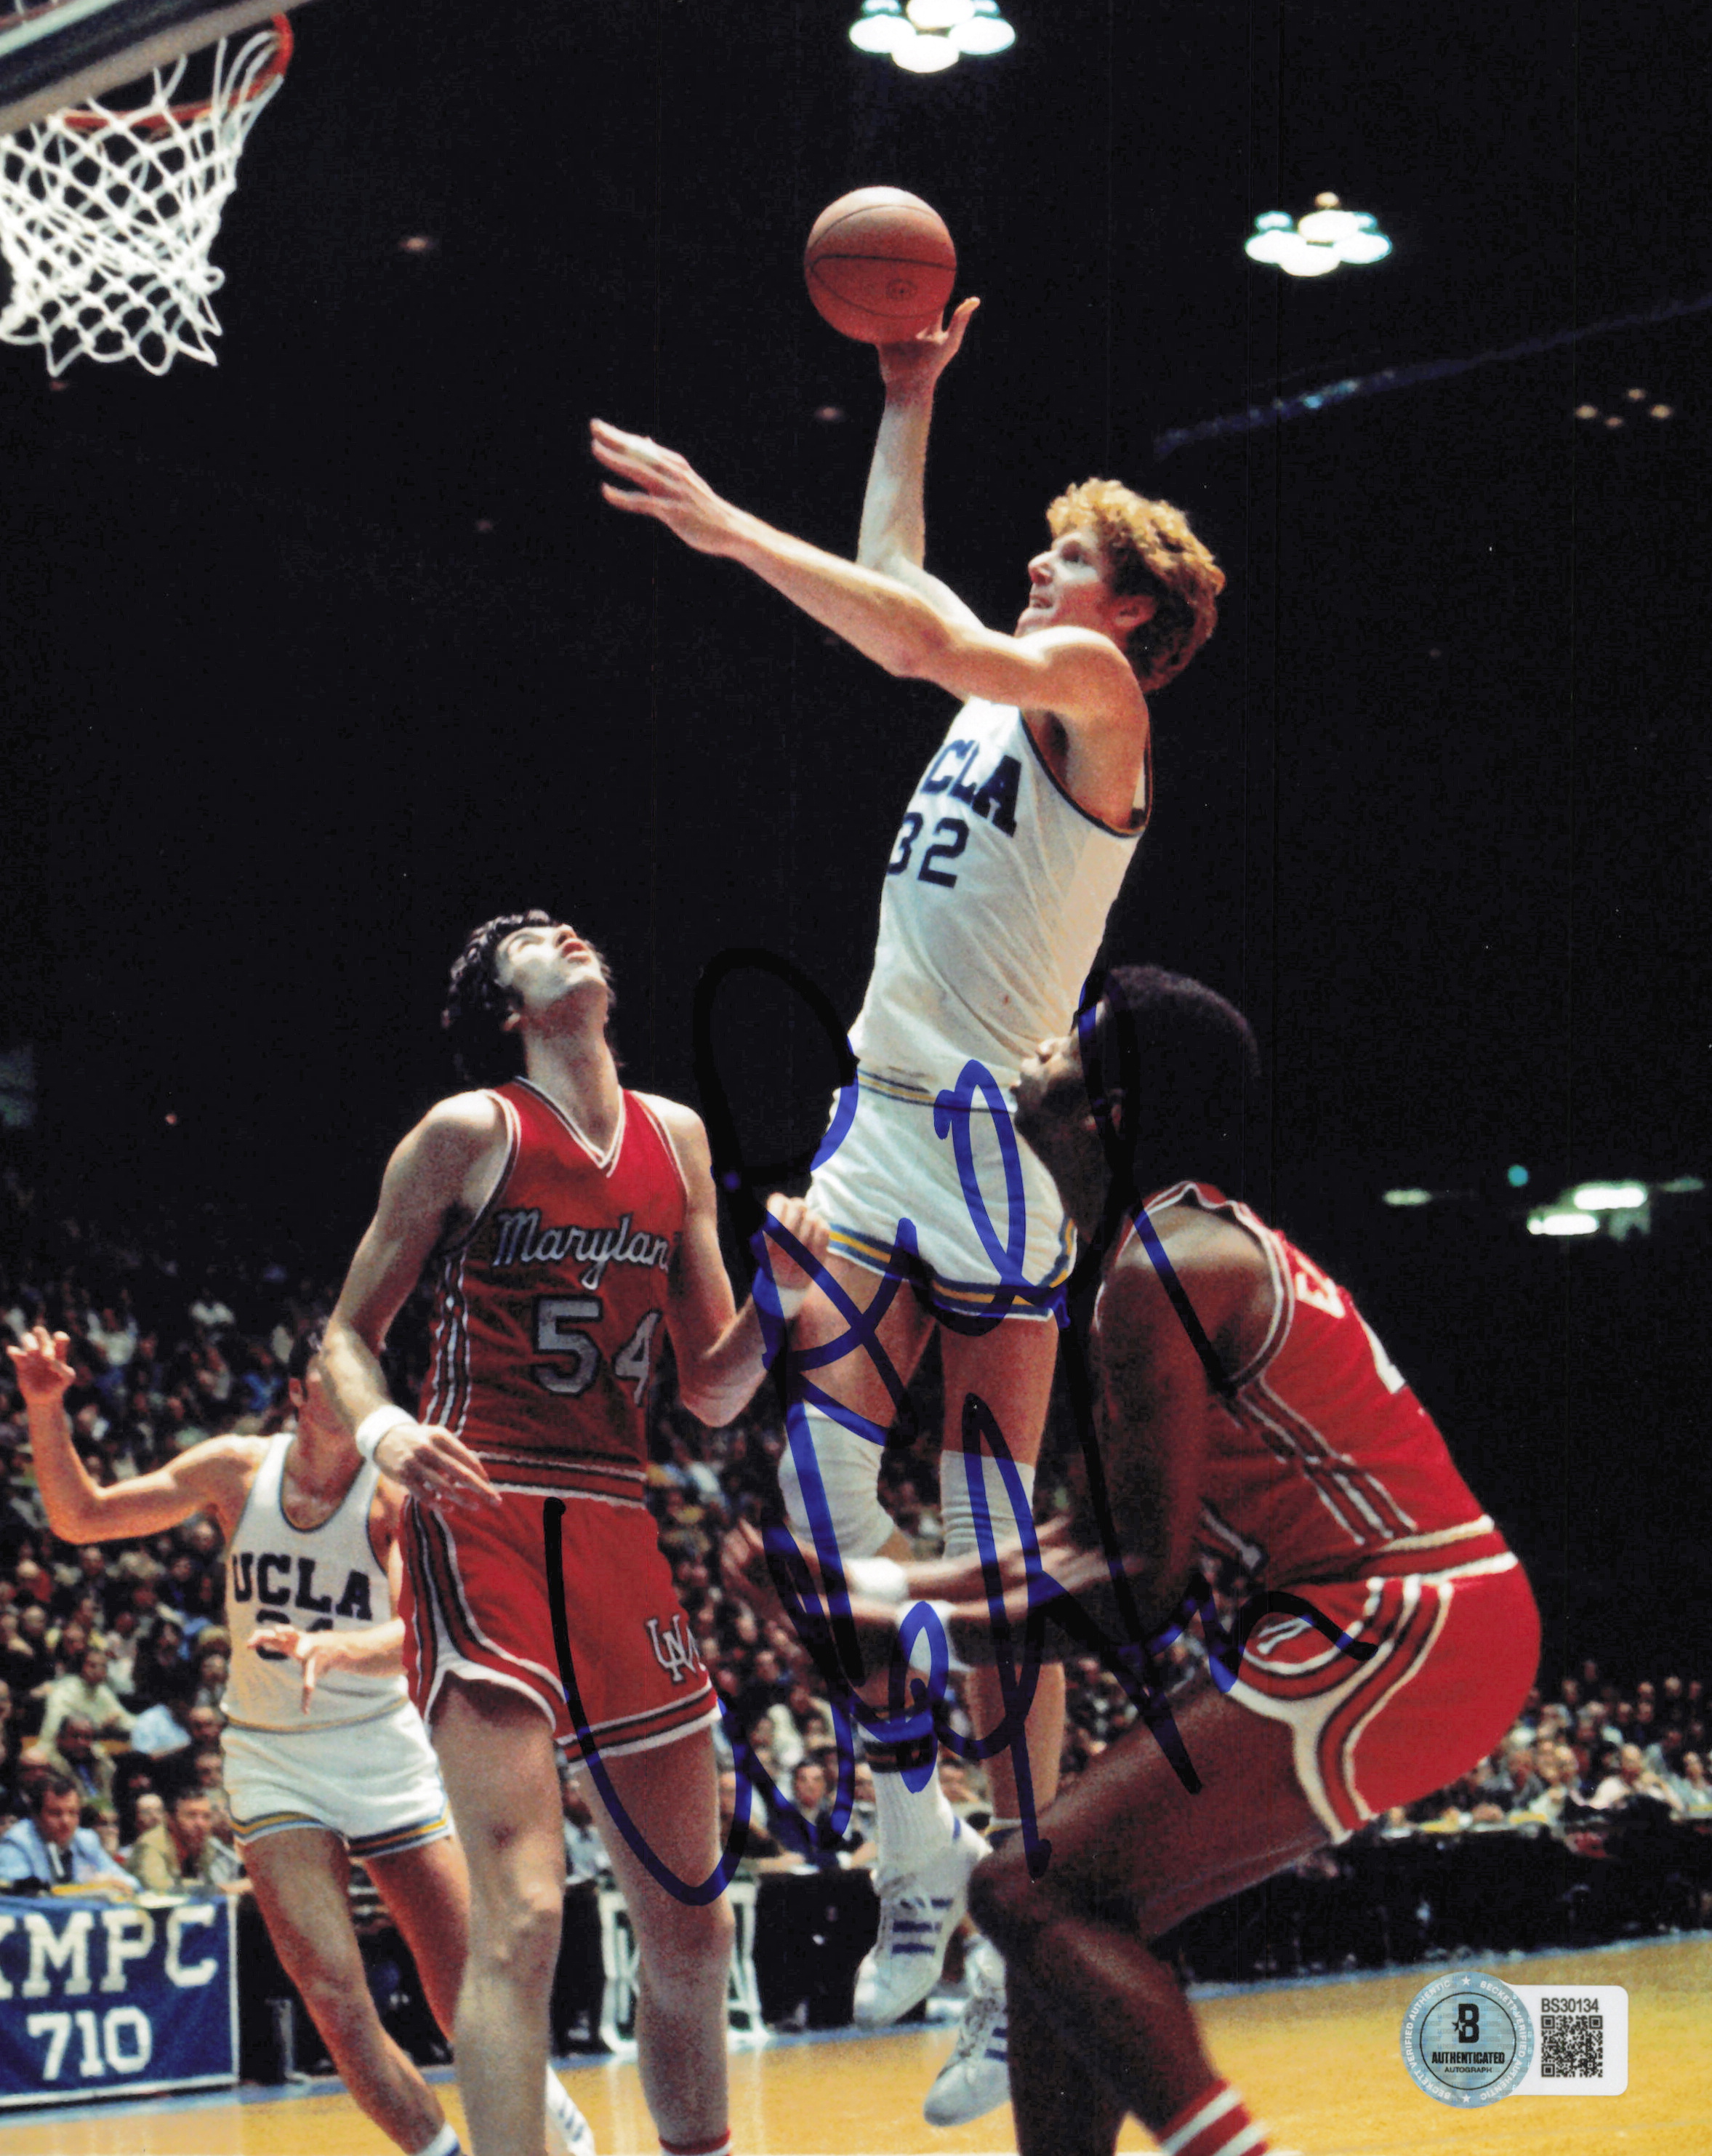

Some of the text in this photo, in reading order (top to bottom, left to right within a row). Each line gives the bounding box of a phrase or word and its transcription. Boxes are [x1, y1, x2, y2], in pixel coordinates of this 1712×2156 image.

[919, 738, 1022, 838] CLA
[885, 811, 970, 889] 32
[490, 1207, 670, 1291] Marylan
[531, 1294, 662, 1406] 54
[231, 1552, 373, 1622] UCLA
[0, 1905, 217, 2000] MPC
[26, 2005, 152, 2081] 710
